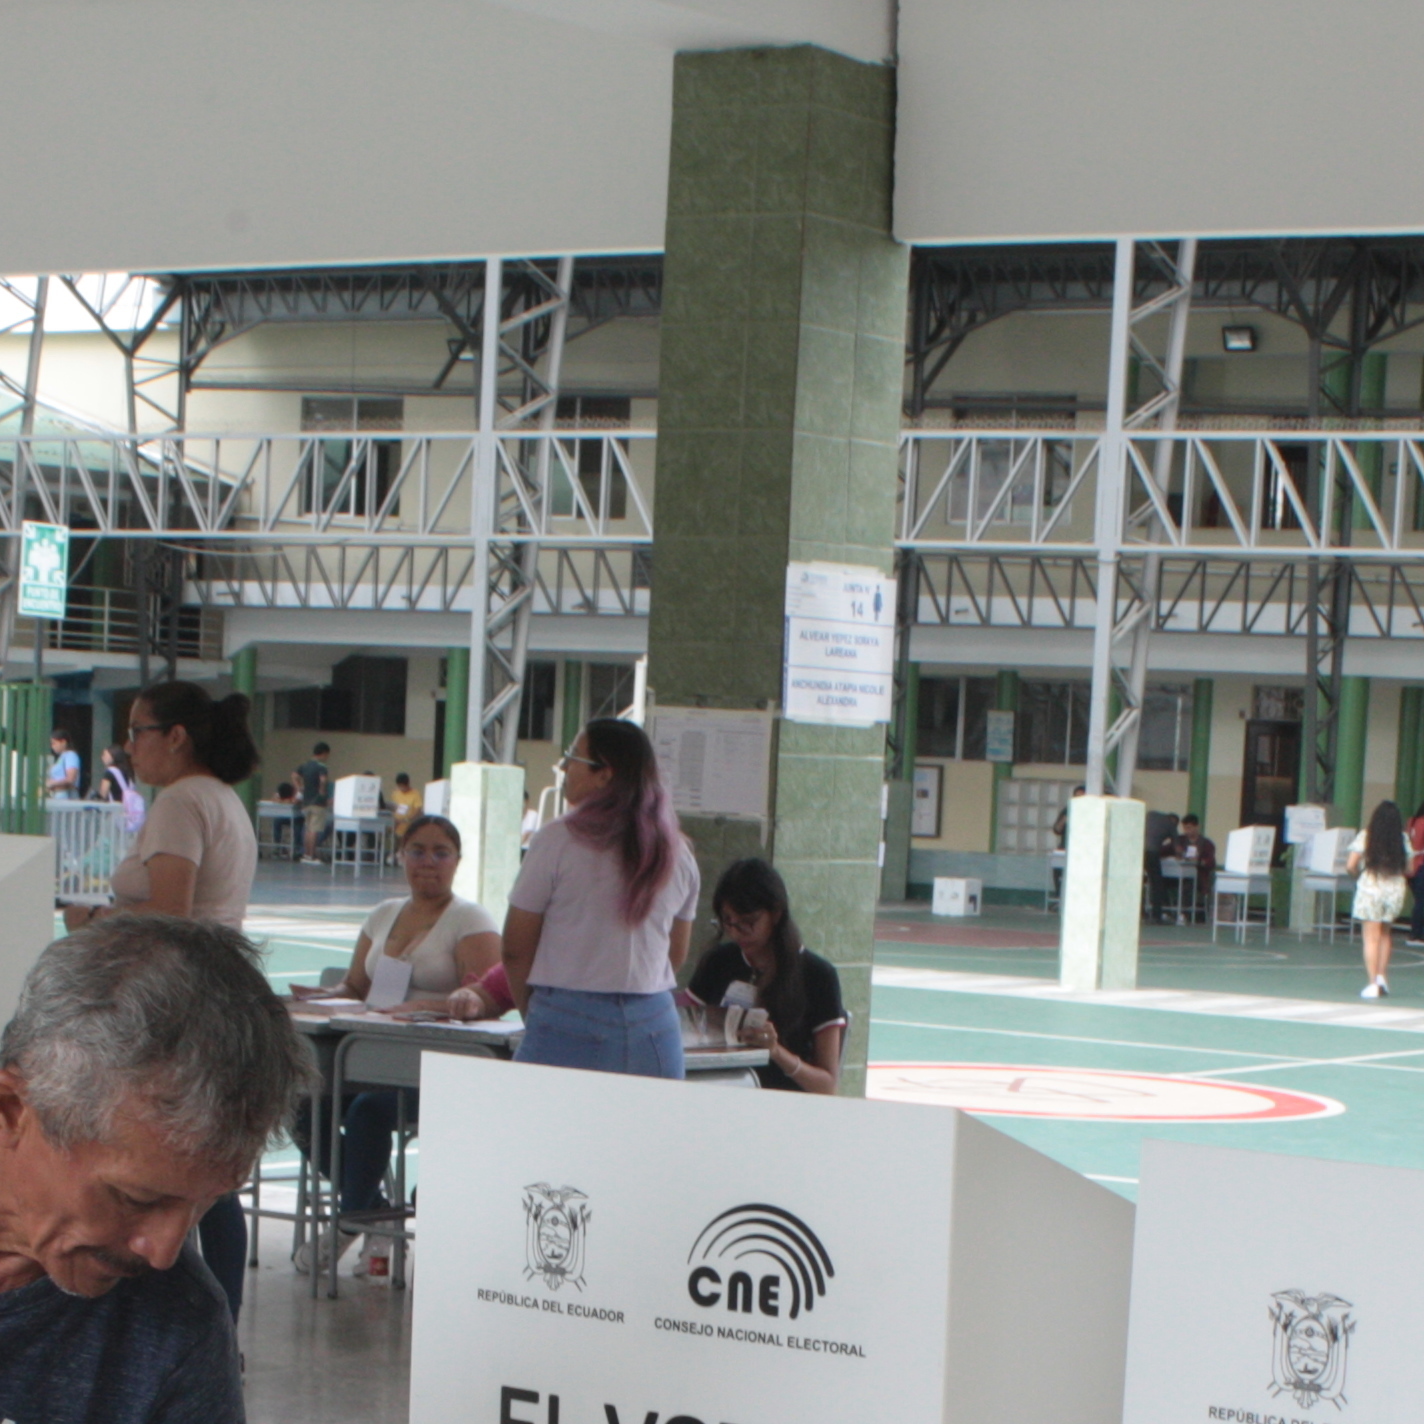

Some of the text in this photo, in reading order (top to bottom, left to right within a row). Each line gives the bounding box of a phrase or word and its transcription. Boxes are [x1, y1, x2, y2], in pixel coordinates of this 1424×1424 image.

[851, 601, 864, 618] 14
[476, 1287, 625, 1324] REPÚBLICA DEL ECUADOR
[687, 1265, 780, 1318] CNE
[654, 1316, 867, 1358] CONSEJO NACIONAL ELECTORAL
